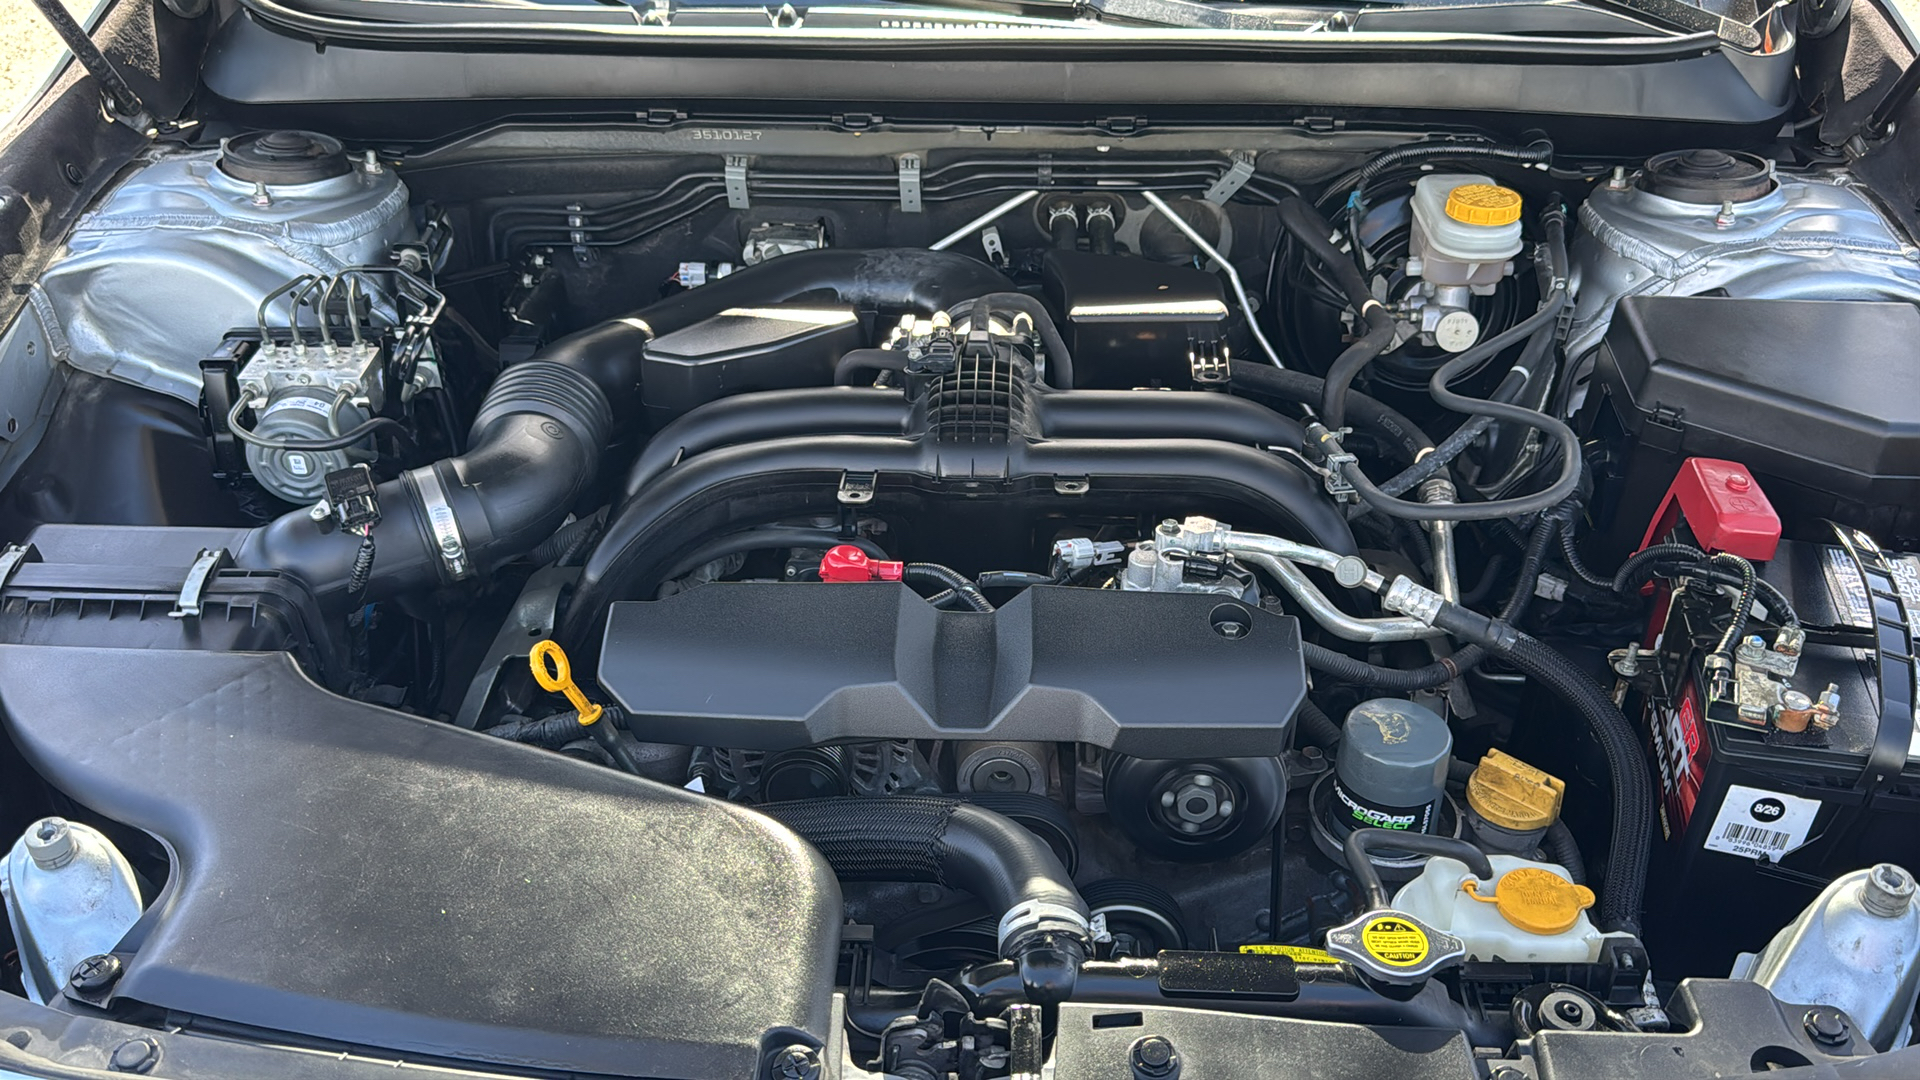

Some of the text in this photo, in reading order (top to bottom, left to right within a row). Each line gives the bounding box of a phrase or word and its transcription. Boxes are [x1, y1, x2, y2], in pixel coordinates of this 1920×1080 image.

[692, 130, 762, 140] 3510127
[1885, 557, 1917, 604] START
[1650, 709, 1672, 796] EMIUM
[1333, 779, 1416, 824] MICROGARD
[1753, 803, 1781, 816] 8/26
[1352, 810, 1413, 830] SELECT
[1383, 952, 1416, 960] CAUTION
